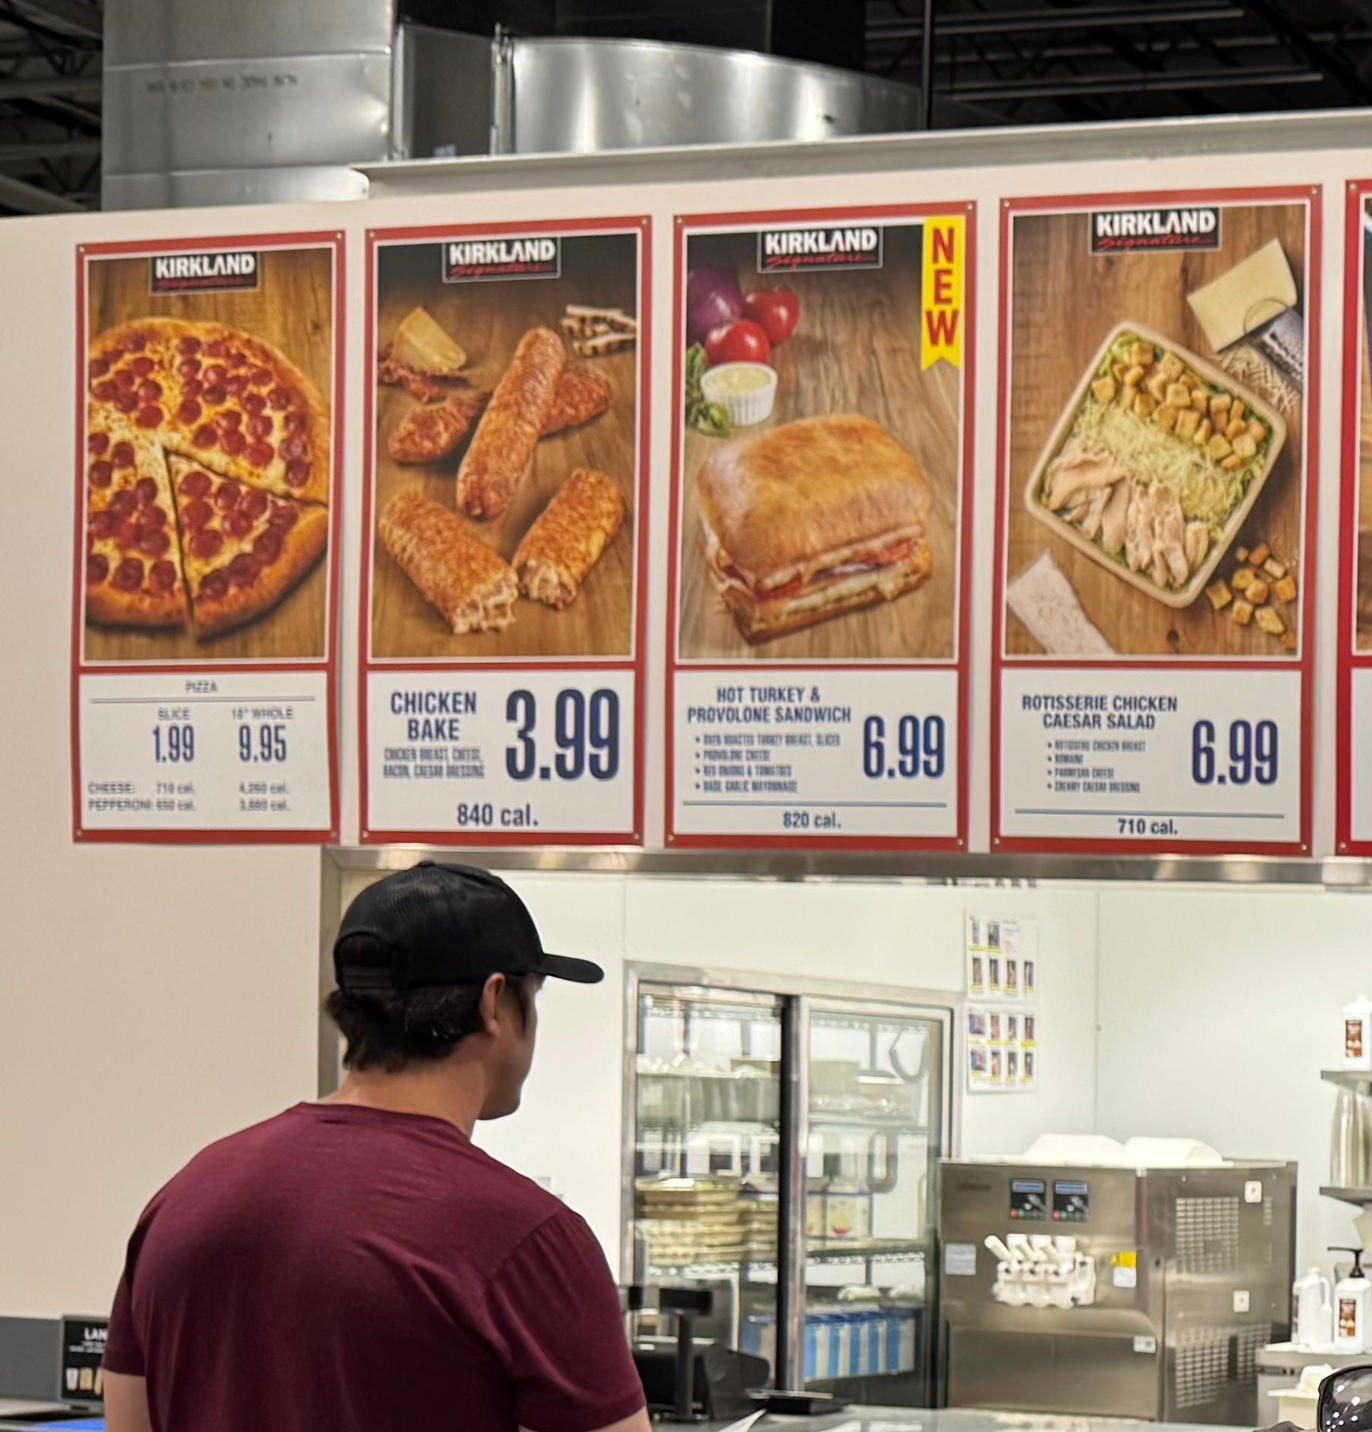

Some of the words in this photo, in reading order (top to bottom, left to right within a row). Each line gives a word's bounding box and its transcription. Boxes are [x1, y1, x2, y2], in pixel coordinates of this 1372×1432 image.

[1097, 212, 1215, 237] KIRKLAND
[450, 239, 555, 264] KIRKLAND
[765, 229, 877, 255] KIRKLAND
[156, 255, 254, 277] KIRKLAND
[925, 228, 959, 346] NEW
[186, 680, 217, 693] PIZZA
[717, 688, 743, 702] HOT
[750, 688, 804, 702] TURKEY
[810, 687, 820, 702] &
[158, 709, 190, 720] SLICE
[252, 708, 293, 719] WHOLE
[391, 692, 476, 714] CHICKEN
[1022, 695, 1107, 711] ROTISSERIE
[1113, 696, 1177, 711] CHICKEN
[688, 708, 770, 722] PROVOLONE
[775, 707, 851, 722] SANDWICH
[1043, 714, 1100, 729] CAESAR
[1107, 714, 1155, 729] SALAD
[408, 719, 460, 741] BAKE
[505, 689, 620, 781] 3.99
[153, 725, 194, 763] 1.99
[239, 725, 286, 762] 9.95
[864, 715, 945, 778] 6.99
[1192, 720, 1278, 785] 6.99
[457, 804, 492, 826] 840
[501, 804, 538, 826] cal.
[783, 812, 809, 828] 820
[814, 812, 841, 828] cal.
[1118, 819, 1145, 834] 710
[1151, 820, 1178, 835] cal.
